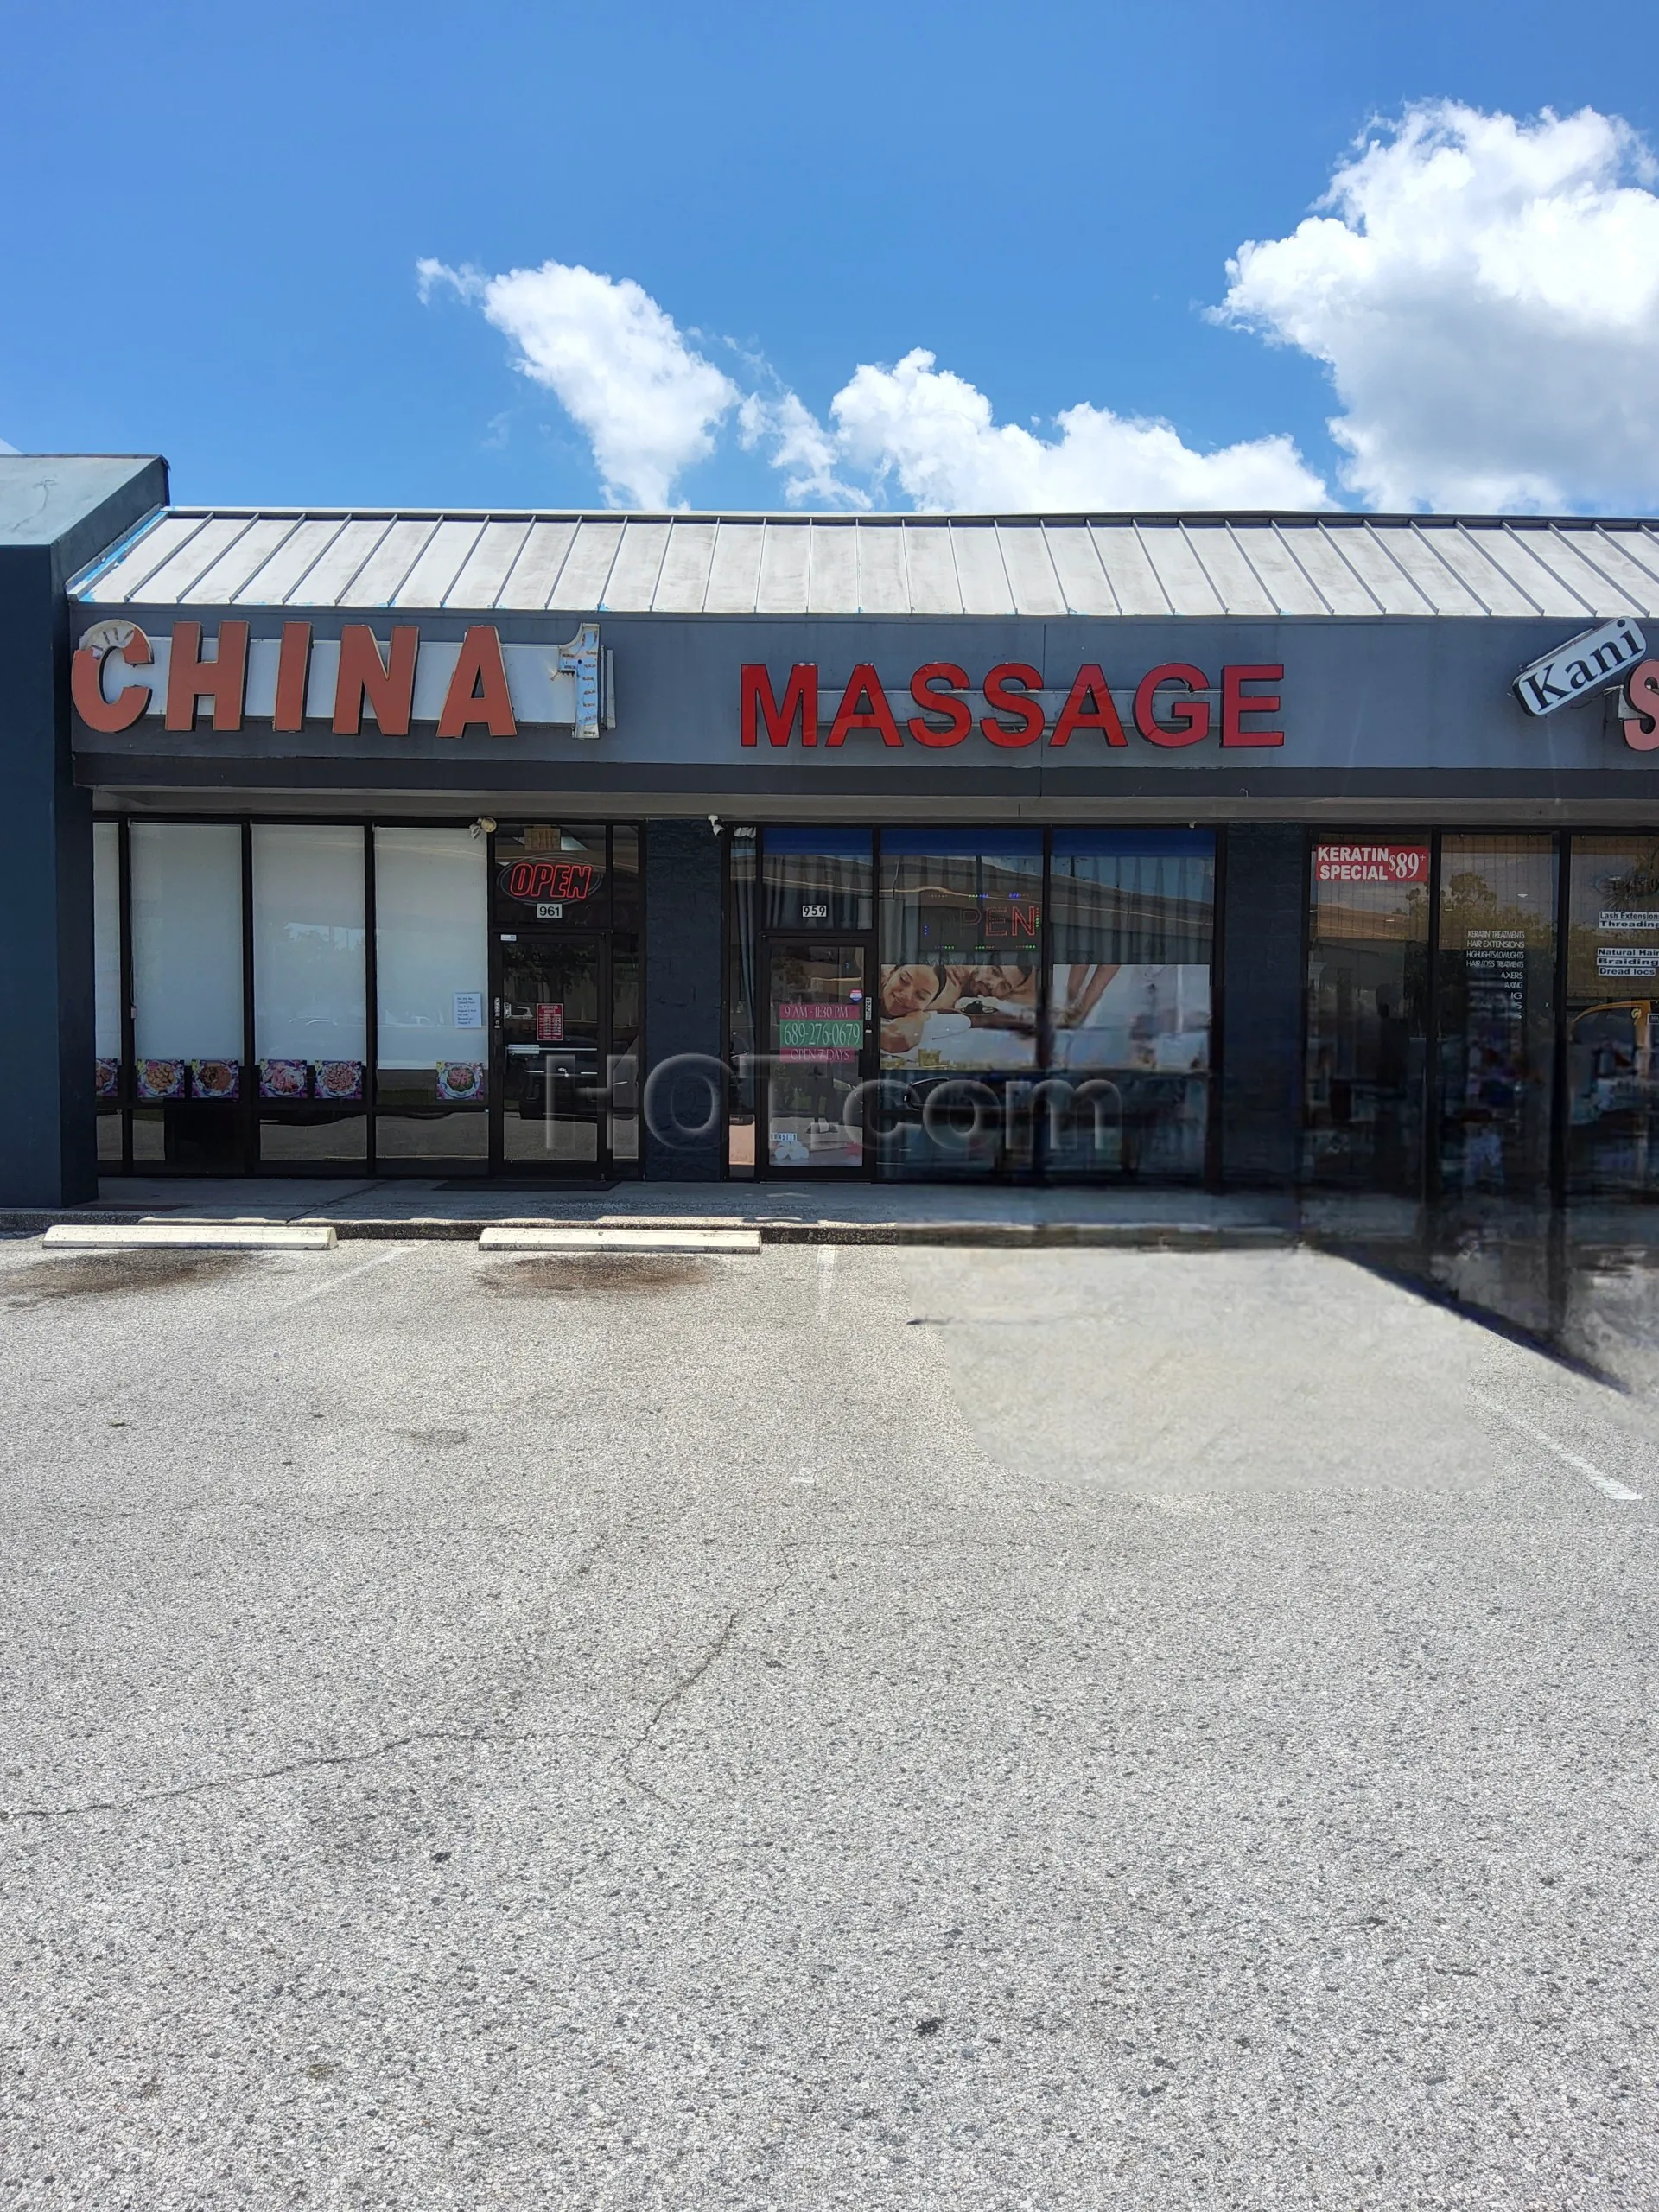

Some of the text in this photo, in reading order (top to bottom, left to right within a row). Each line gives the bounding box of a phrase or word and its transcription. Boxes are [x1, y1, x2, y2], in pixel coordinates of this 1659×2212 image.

[1522, 619, 1643, 712] Kani
[71, 619, 517, 738] CHINA
[740, 662, 1285, 749] MASSAGE
[1318, 847, 1389, 862] KERATIN
[1319, 865, 1389, 880] SPECIAL
[510, 863, 593, 899] OPEN
[539, 906, 560, 917] 961
[804, 906, 826, 916] 959
[959, 906, 1036, 937] PEN
[1467, 930, 1525, 939] KERATIN TREATMENTS
[1483, 940, 1525, 949] EXTENSIONS
[1496, 960, 1525, 969] TREATMENTS
[1598, 957, 1659, 967] Braiding
[784, 1006, 791, 1017] 9
[792, 1006, 808, 1018] AM
[835, 1006, 849, 1018] PM
[784, 1022, 861, 1046] 689-276-0679
[791, 1048, 816, 1061] OPEN
[826, 1048, 849, 1061] DAYS
